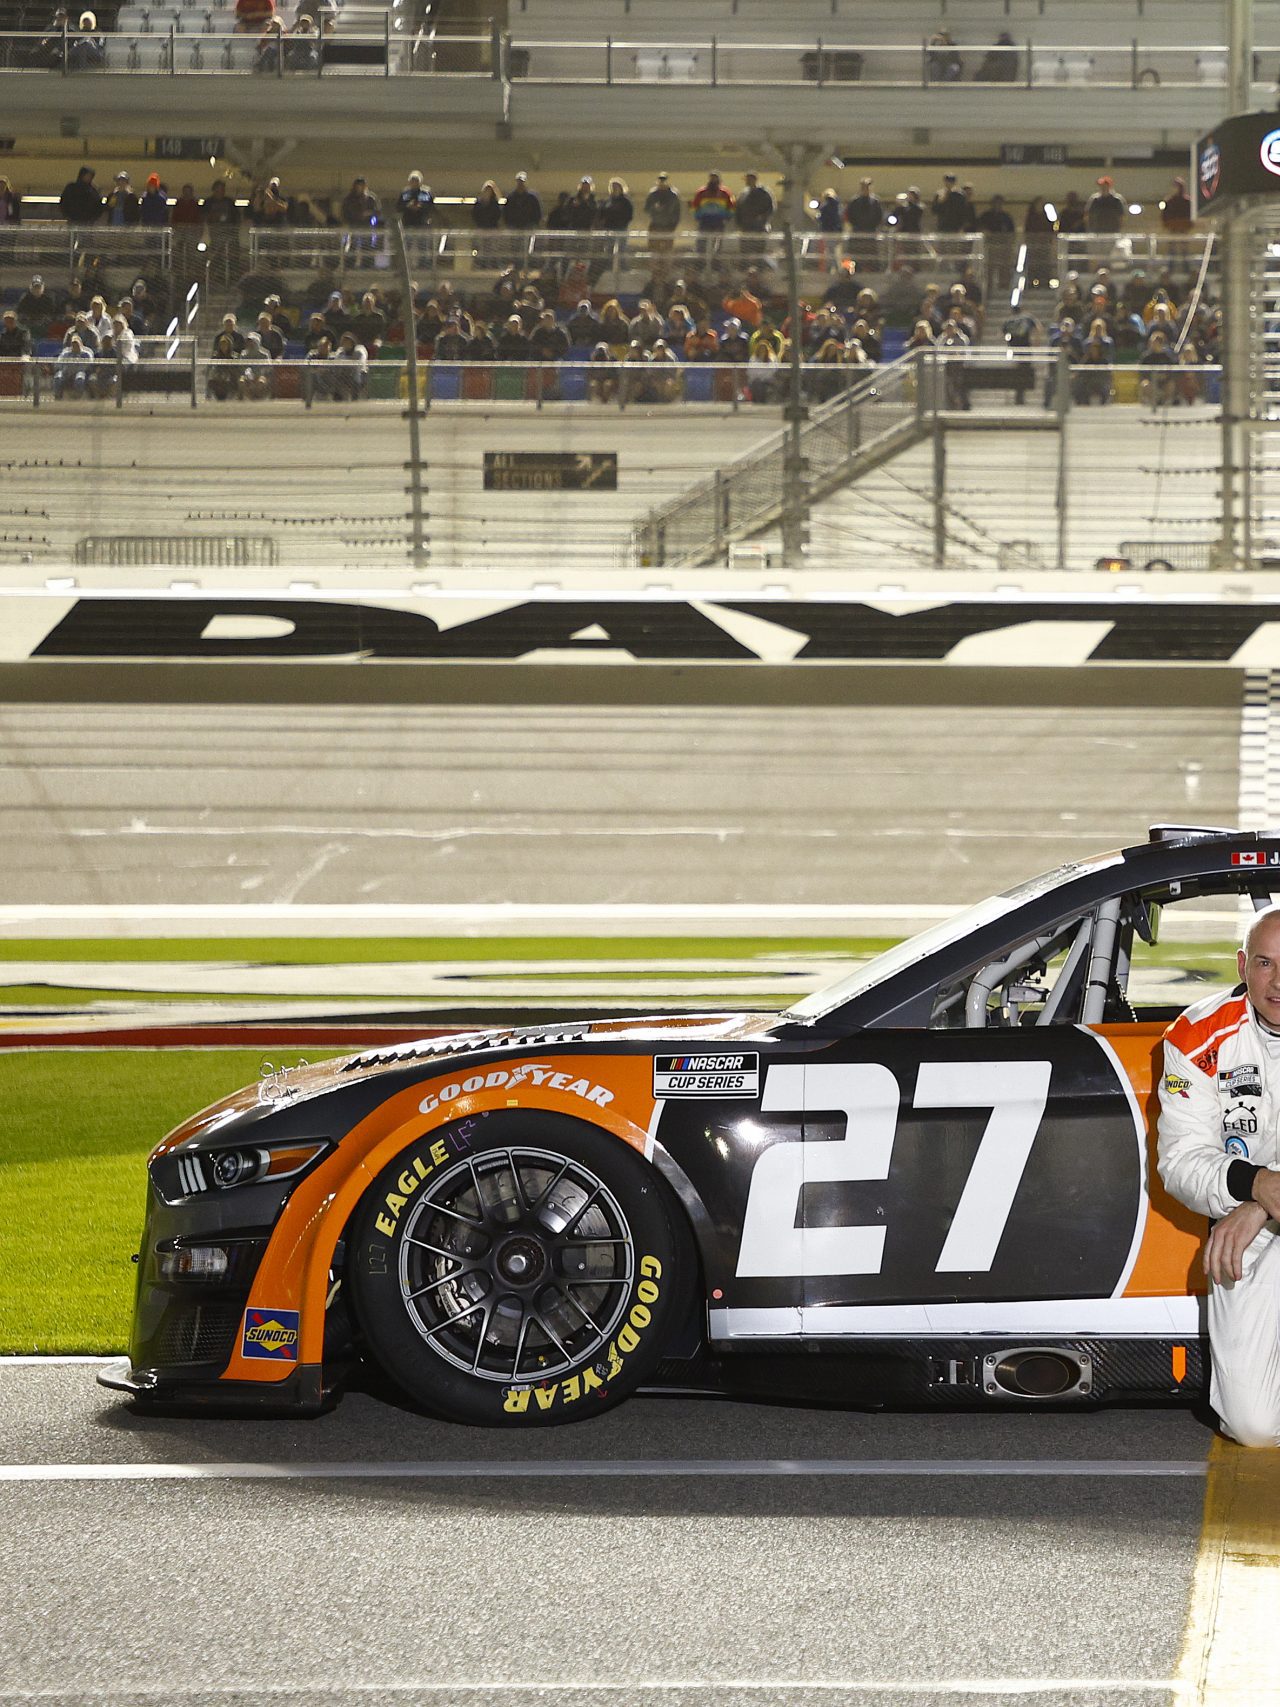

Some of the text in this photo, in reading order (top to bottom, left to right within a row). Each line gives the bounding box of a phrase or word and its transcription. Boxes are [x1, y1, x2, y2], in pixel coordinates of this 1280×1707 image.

[492, 471, 562, 489] SECTIONS
[688, 1055, 744, 1070] NASCAR
[418, 1064, 615, 1114] GOODYEAR
[668, 1075, 744, 1089] CUP SERIES
[1165, 1080, 1190, 1088] NOCO
[1225, 1076, 1256, 1088] CUP SERIES
[735, 1060, 1053, 1278] 27
[374, 1139, 450, 1238] EAGLE
[247, 1327, 296, 1343] SUNOCO
[503, 1255, 663, 1413] GOODYEAR
